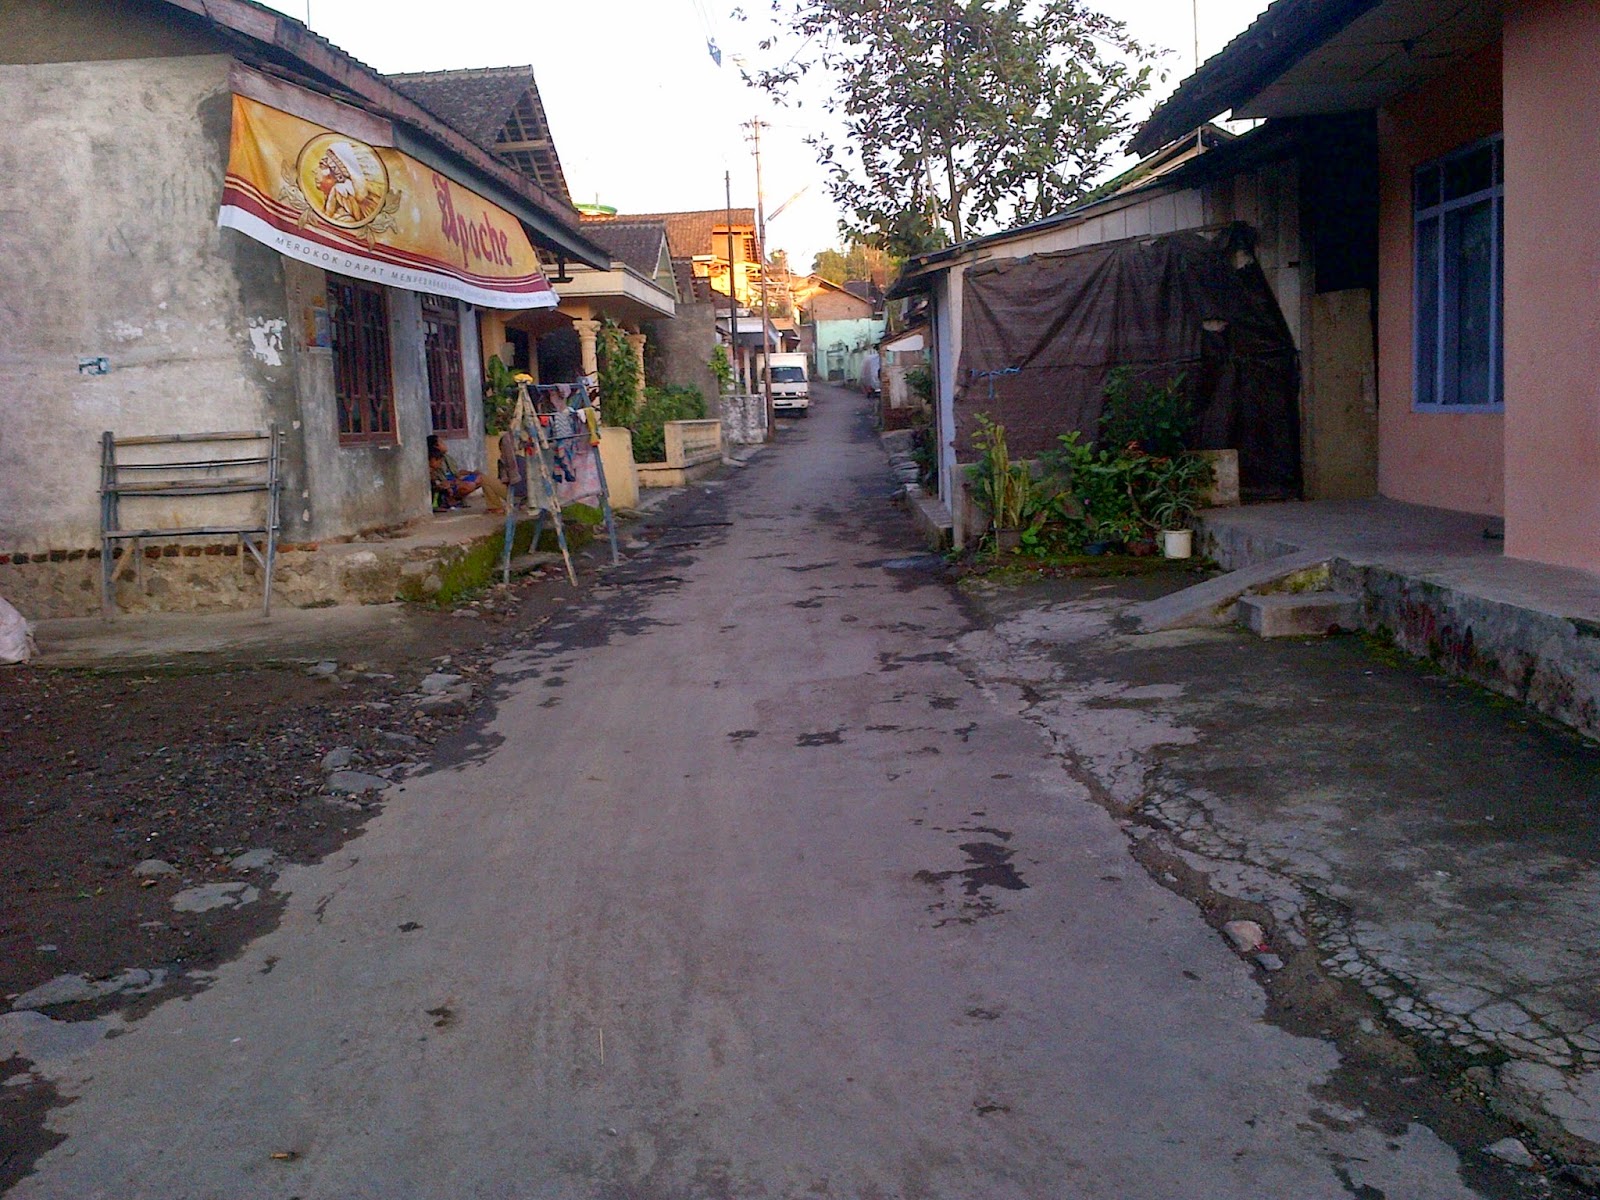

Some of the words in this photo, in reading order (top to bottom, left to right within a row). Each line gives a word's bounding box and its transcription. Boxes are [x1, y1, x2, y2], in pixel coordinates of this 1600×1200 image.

[432, 173, 513, 269] Apache
[275, 237, 338, 264] MEROKOK
[344, 260, 384, 276] DAPAT
